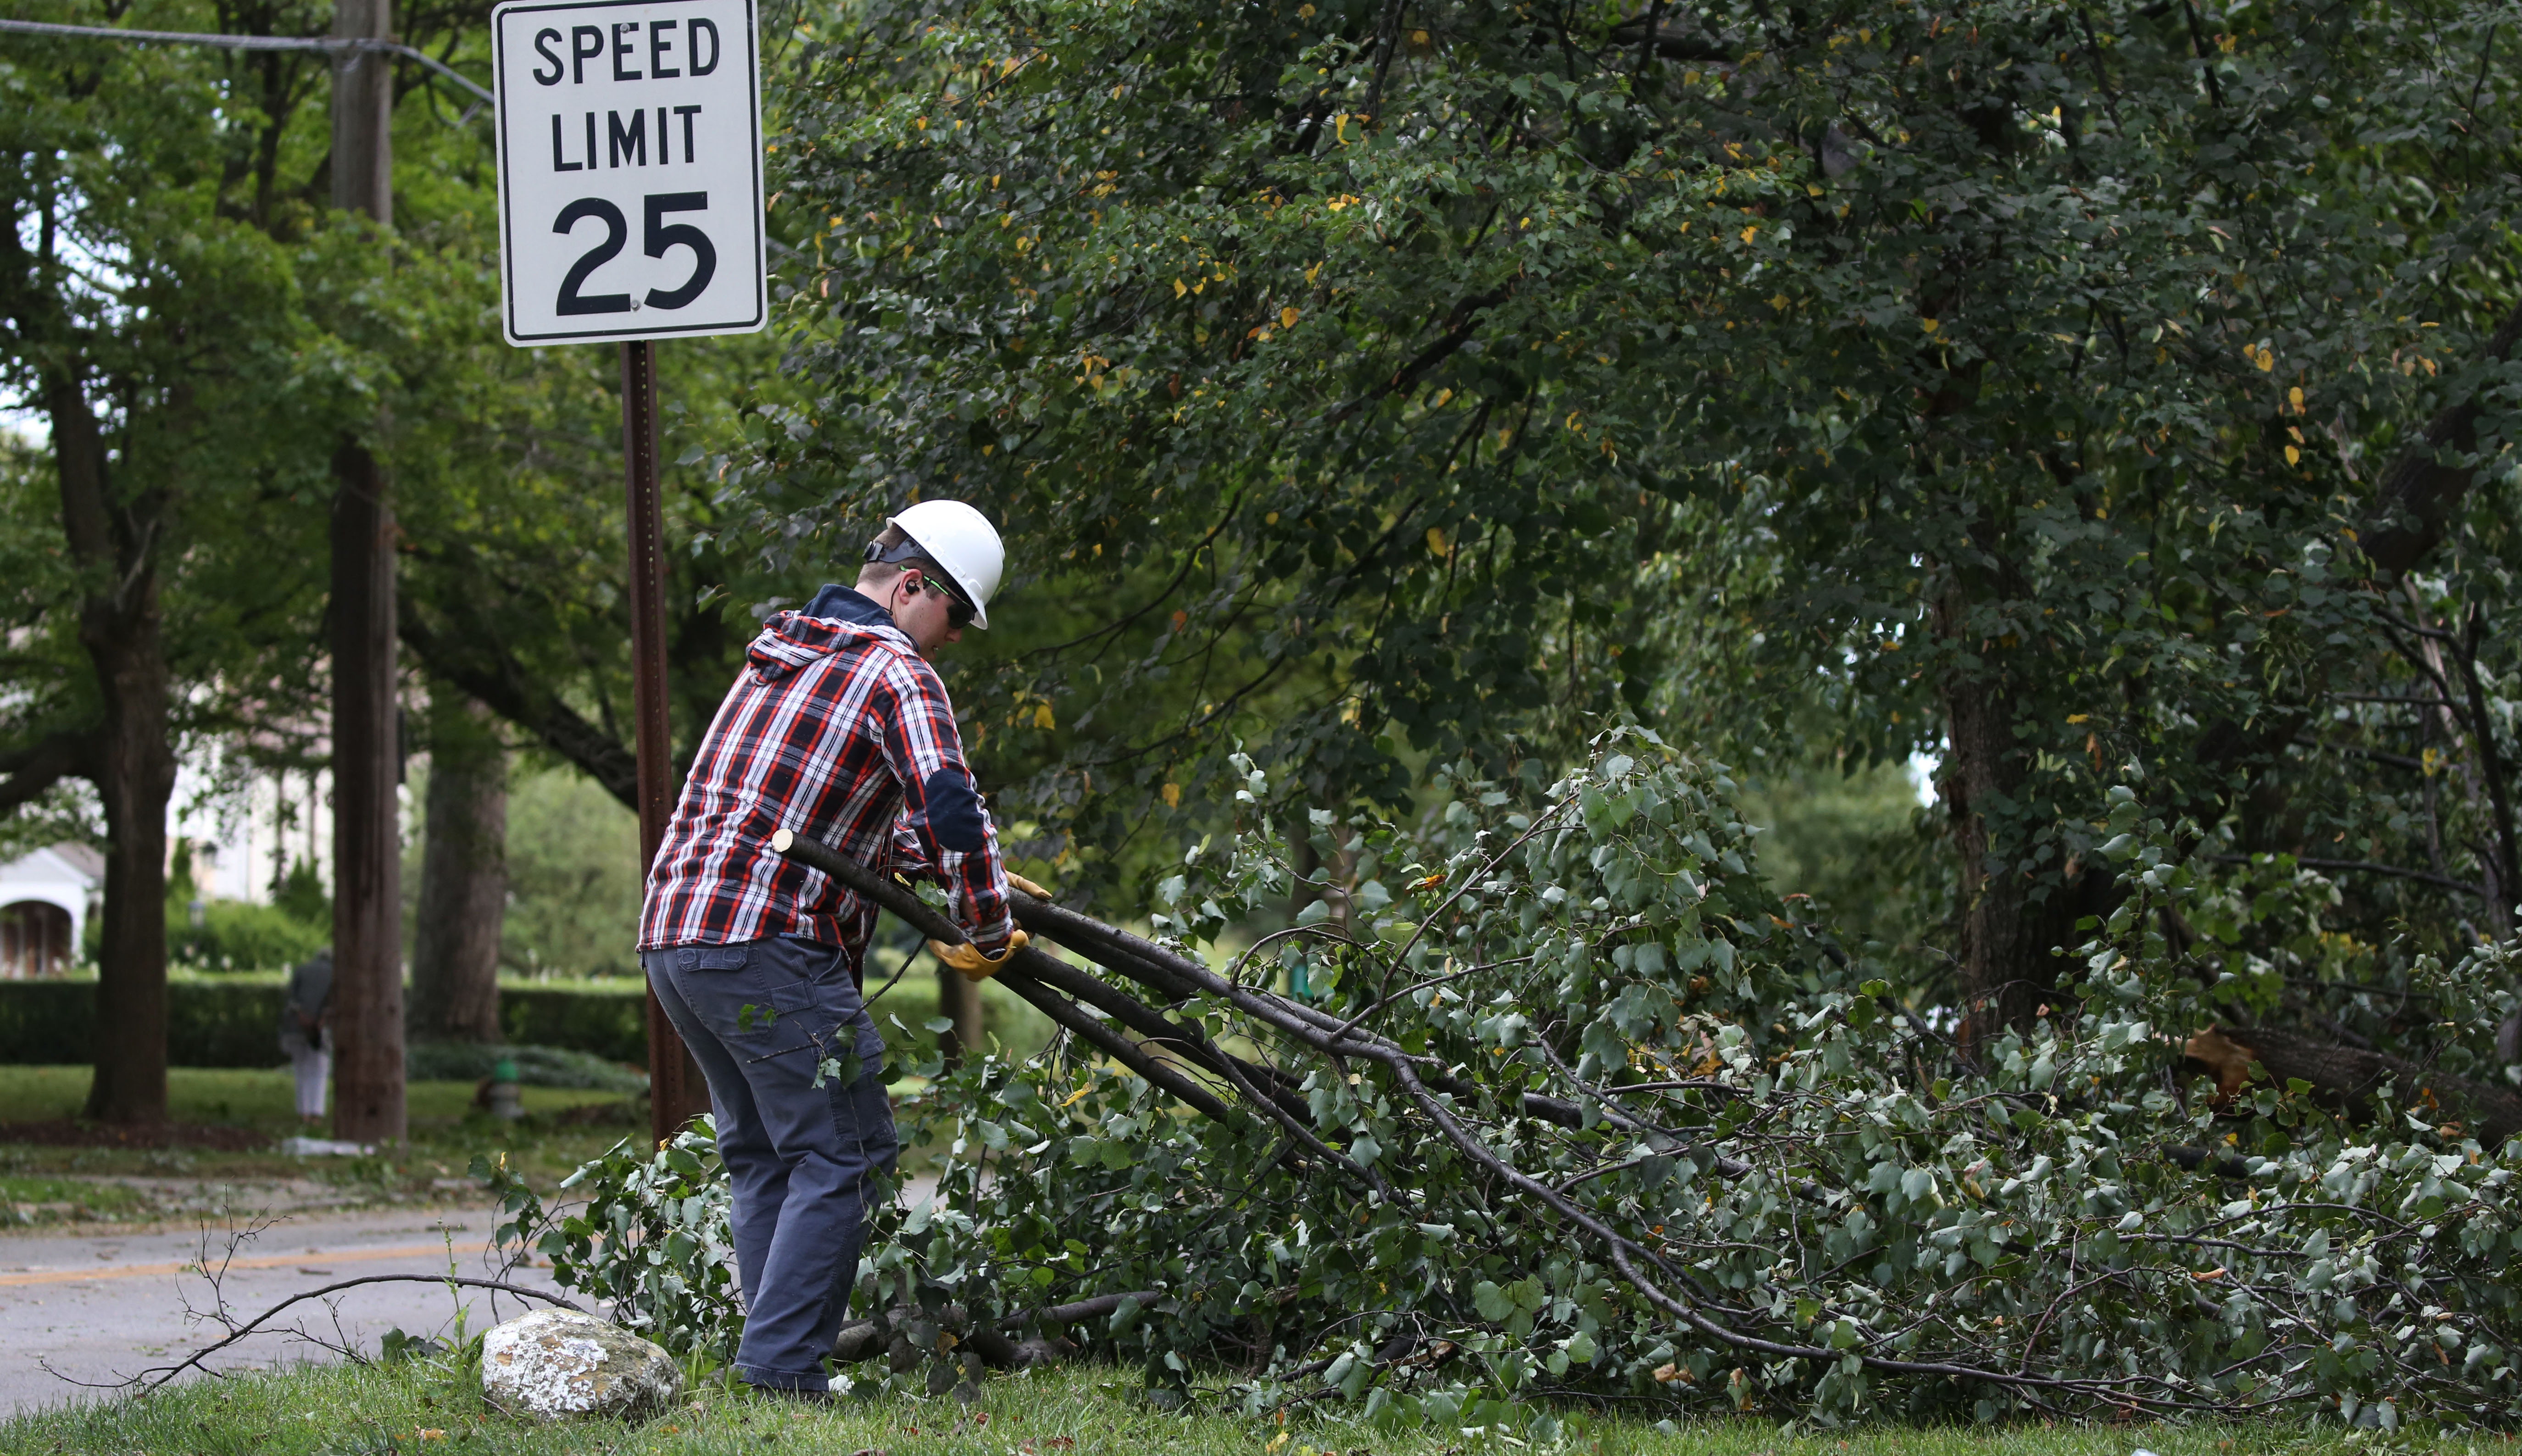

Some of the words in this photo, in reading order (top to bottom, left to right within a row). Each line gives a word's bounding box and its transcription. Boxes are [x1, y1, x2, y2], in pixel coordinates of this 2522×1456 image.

[533, 17, 719, 86] SPEED
[552, 105, 701, 172] LIMIT
[552, 191, 717, 316] 25
